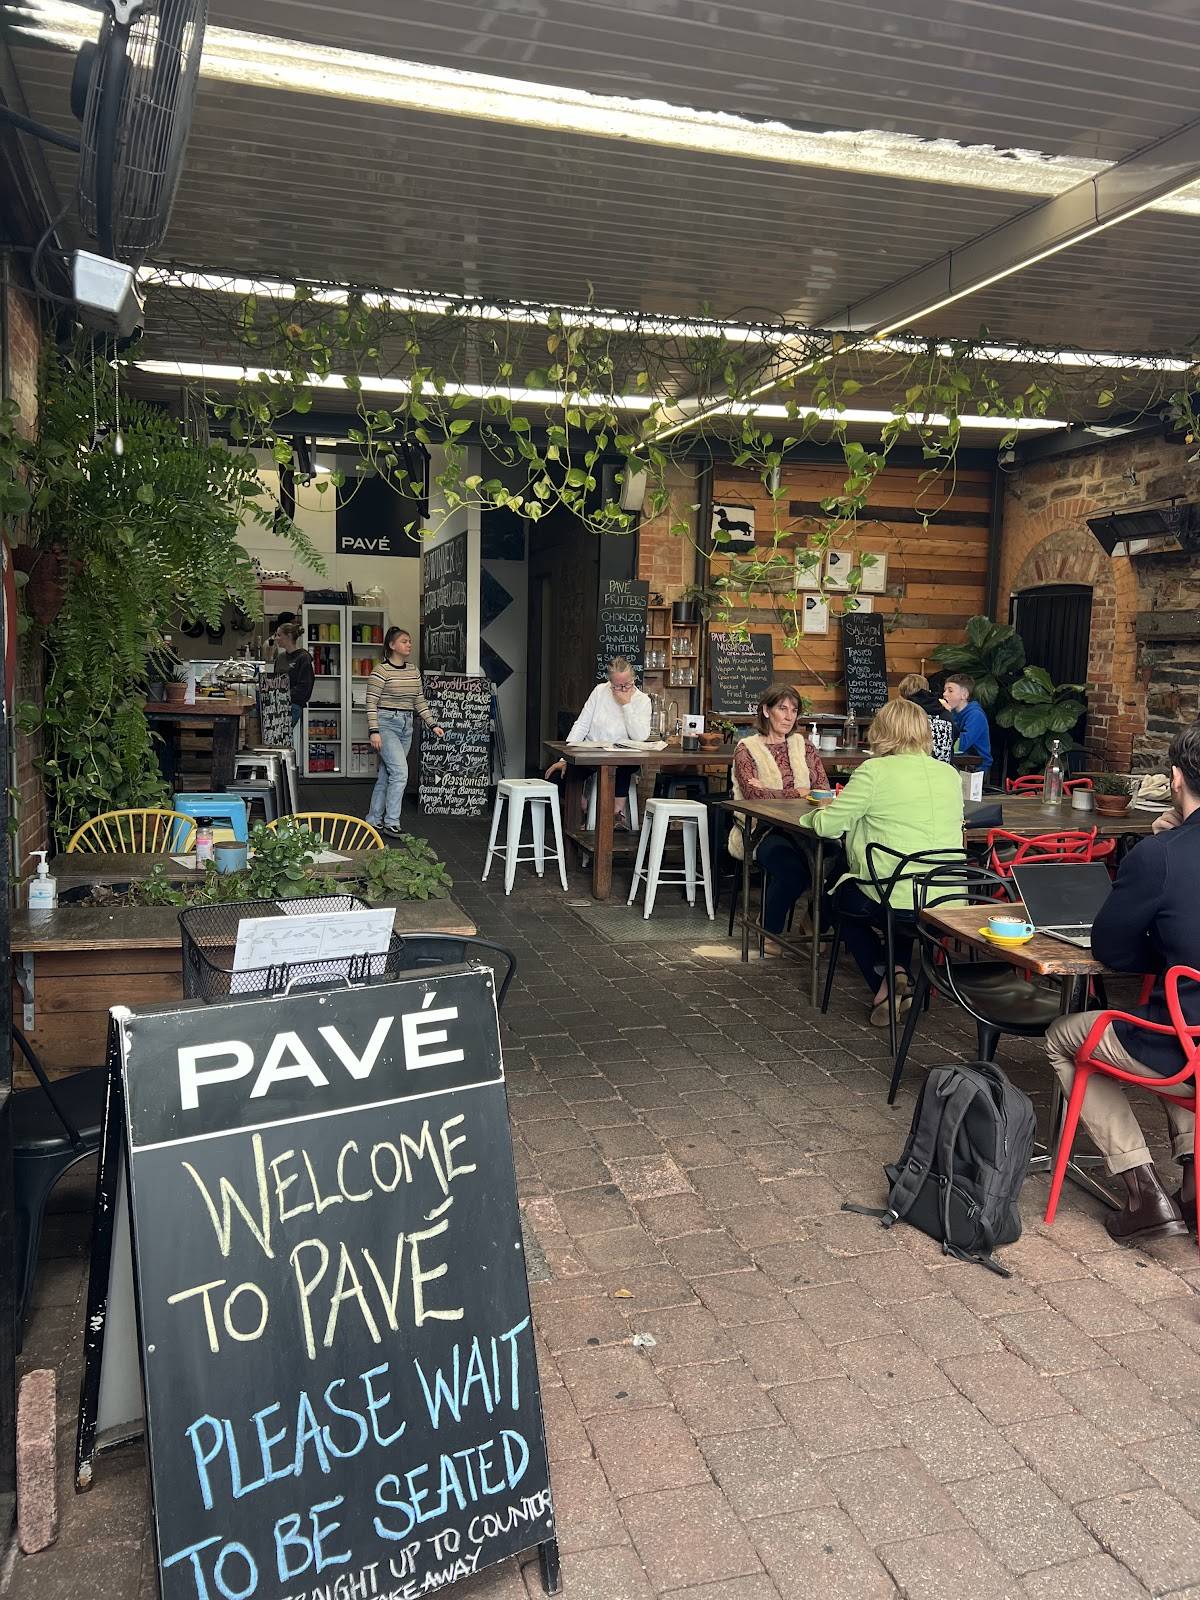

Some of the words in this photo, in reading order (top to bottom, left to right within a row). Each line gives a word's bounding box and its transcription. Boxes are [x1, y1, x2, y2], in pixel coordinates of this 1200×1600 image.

[341, 536, 391, 551] PAVÉ
[609, 579, 631, 595] PAVÉ
[604, 593, 647, 606] FRITTERS
[601, 611, 643, 623] CHORIZO,
[605, 623, 638, 634] POLENTA
[846, 623, 881, 636] SALMON
[600, 634, 638, 644] CANNELINI
[855, 634, 882, 647] BAGEL
[606, 643, 641, 653] FRITTERS
[717, 642, 755, 654] MUSHROOM
[845, 647, 872, 657] TOASTED
[427, 675, 482, 692] Smoothies
[442, 689, 465, 700] Banana
[466, 691, 491, 704] Brekkie
[727, 690, 743, 698] Fried
[461, 700, 490, 712] Cinnamon
[442, 707, 463, 719] Protein
[465, 709, 490, 720] Powder
[443, 730, 465, 745] Berry
[422, 752, 443, 765] Mango
[447, 762, 460, 772] Ice
[441, 773, 489, 787] Passionista
[444, 795, 465, 807] Mango
[424, 803, 450, 814] Coconut
[177, 991, 465, 1111] PAVÉ
[181, 1113, 477, 1259] WELCOME
[167, 1279, 269, 1353] TO
[289, 1195, 464, 1360] PAVÉ
[185, 1362, 407, 1510] PLEASE
[414, 1316, 531, 1429] WAIT
[162, 1535, 258, 1600] TO
[274, 1495, 353, 1583] BE
[373, 1430, 530, 1540] SEATED
[389, 1541, 421, 1578] UP
[426, 1528, 461, 1560] TO
[468, 1488, 554, 1544] COUNTER
